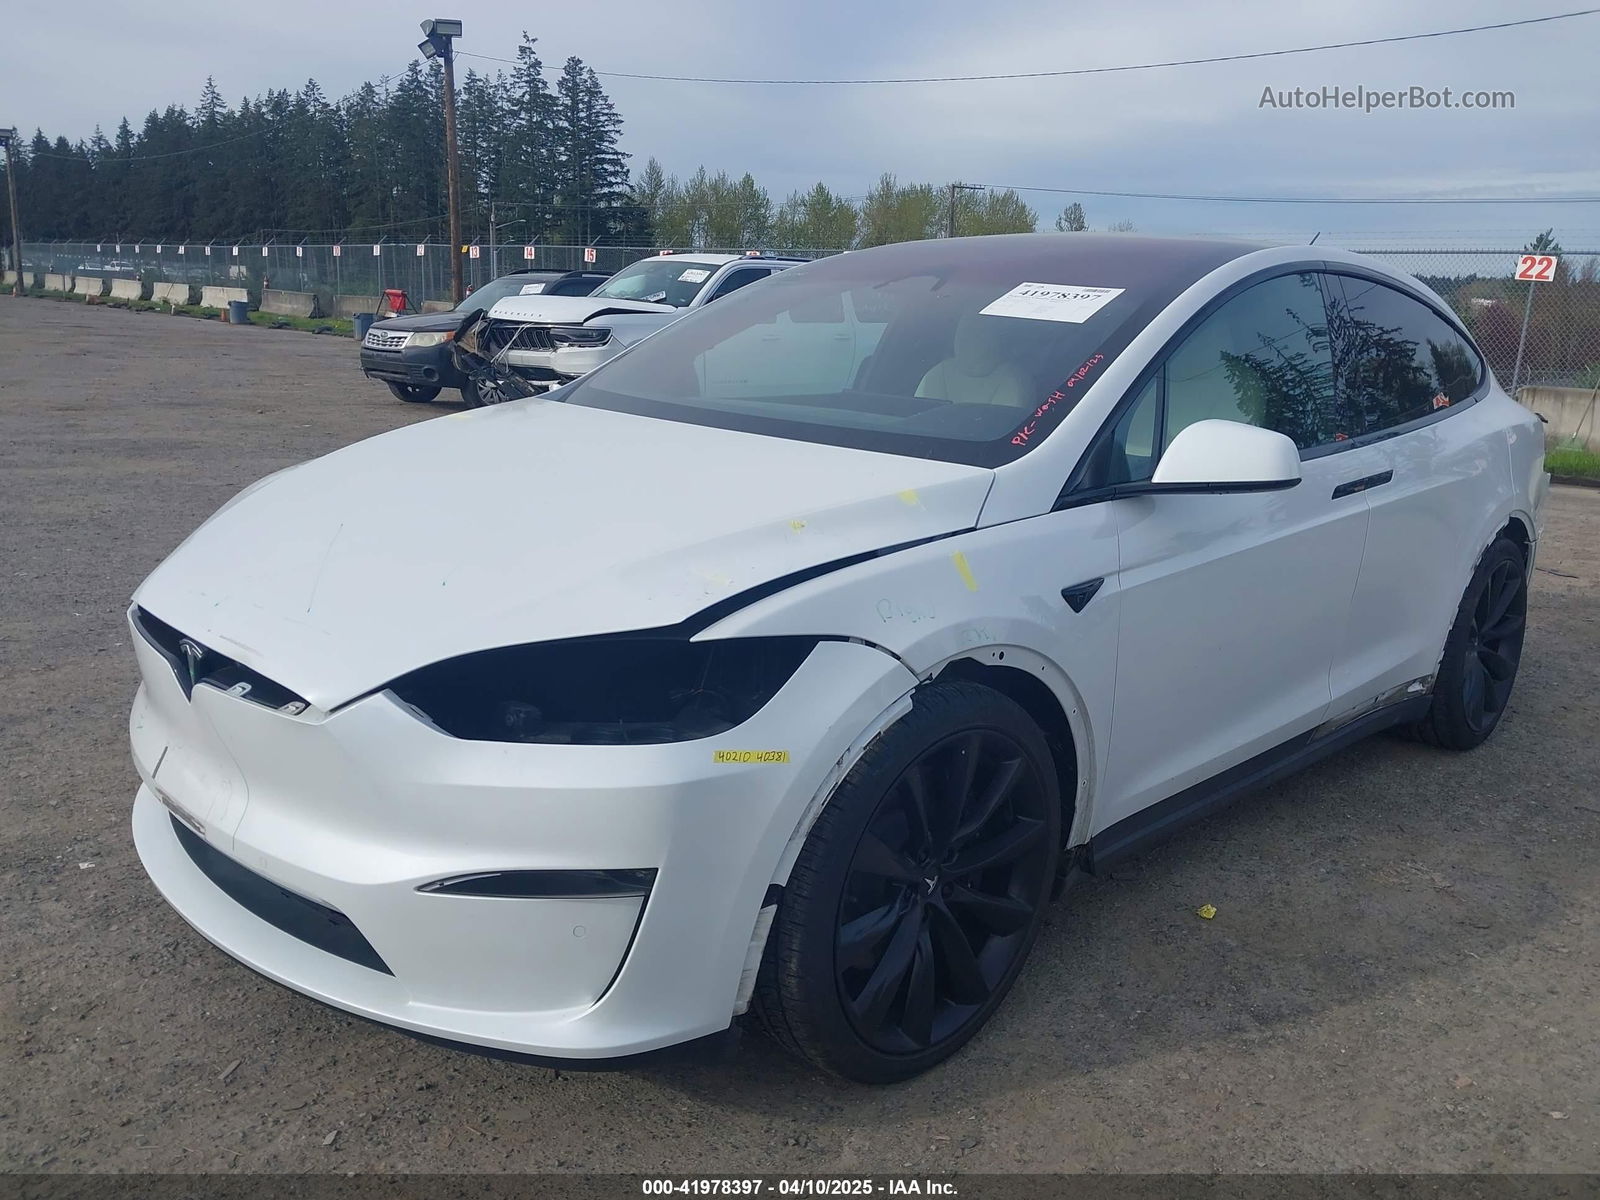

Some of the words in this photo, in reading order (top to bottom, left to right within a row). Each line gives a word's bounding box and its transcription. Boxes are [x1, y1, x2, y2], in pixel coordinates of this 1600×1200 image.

[471, 247, 478, 257] 13
[525, 248, 533, 257] 14
[586, 249, 595, 262] 15
[1519, 256, 1553, 280] 22
[1020, 289, 1102, 301] 41978397
[718, 751, 751, 763] 40210
[756, 751, 786, 763] 40381
